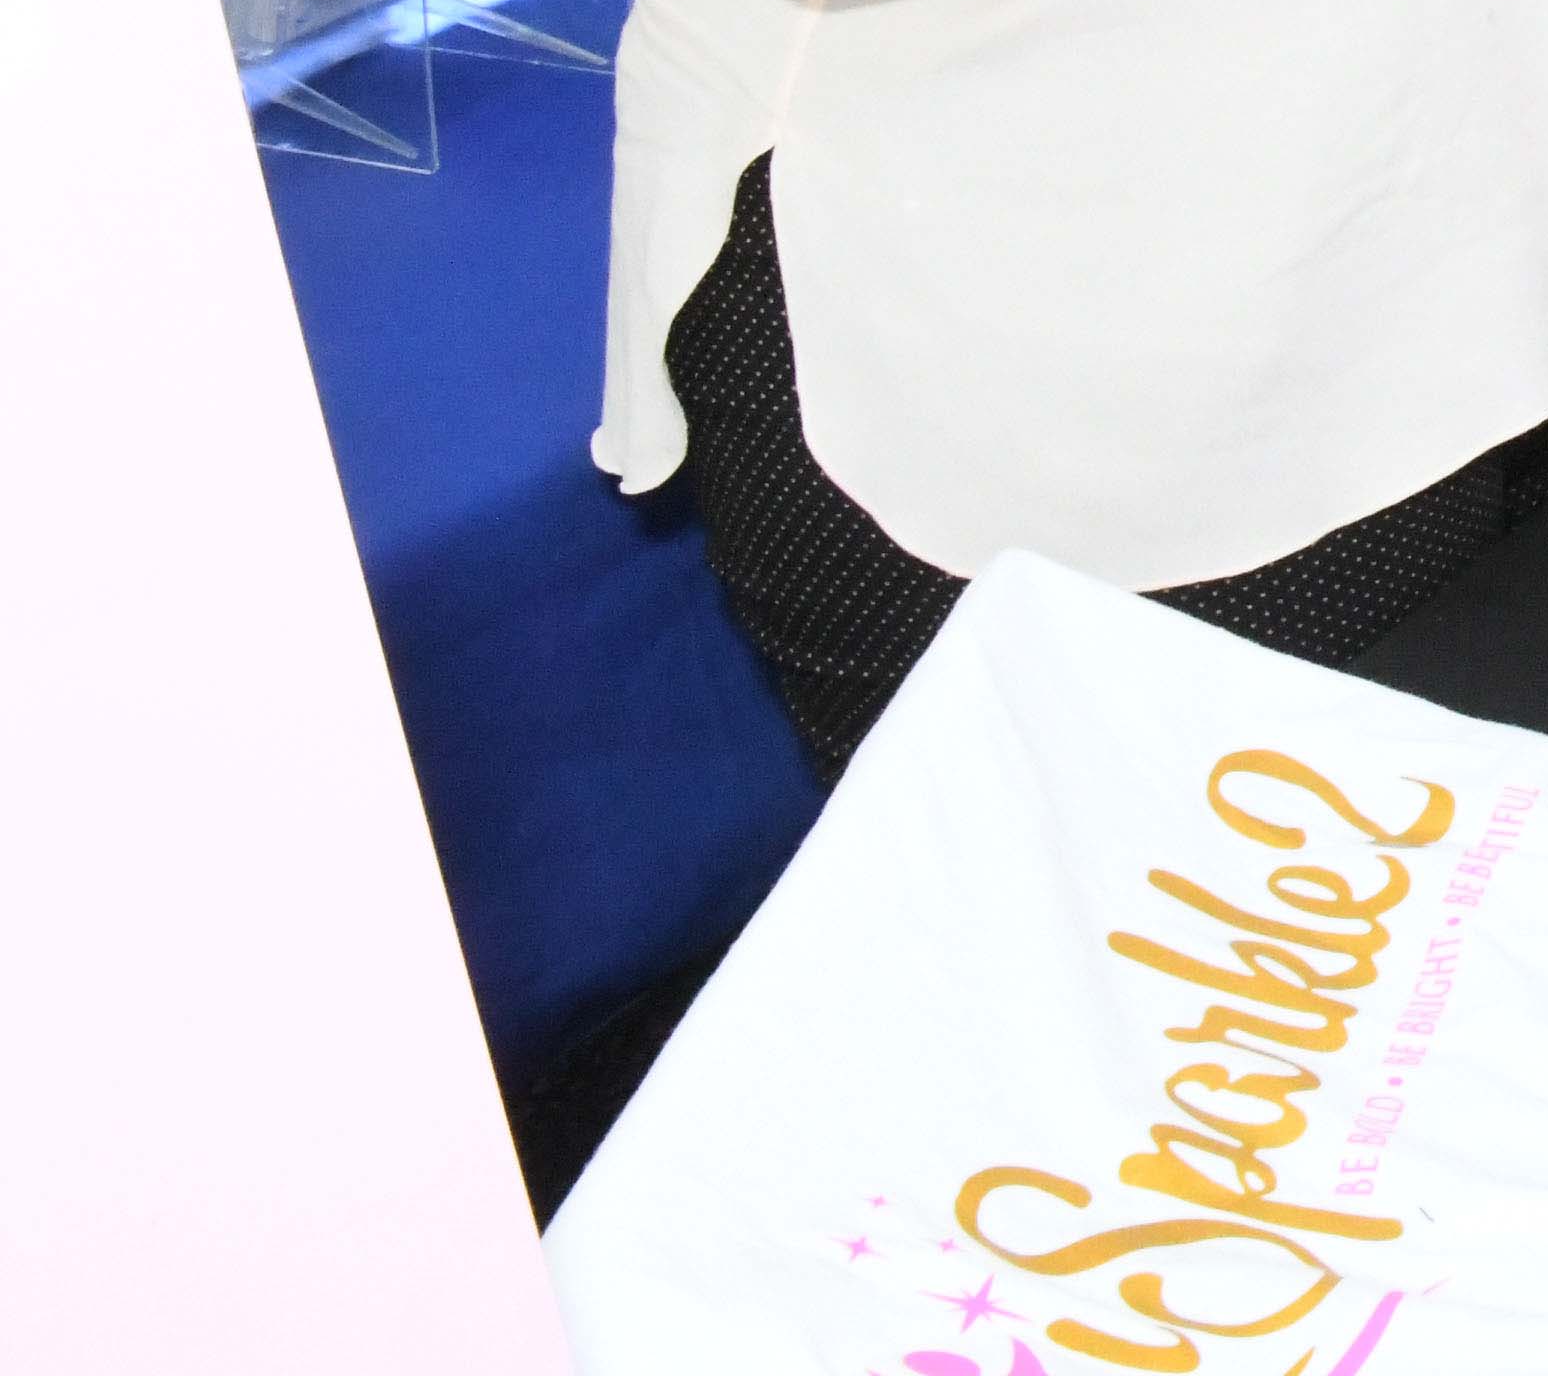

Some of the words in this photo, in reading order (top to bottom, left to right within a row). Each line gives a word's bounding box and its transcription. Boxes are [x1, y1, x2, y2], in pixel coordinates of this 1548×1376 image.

[1398, 936, 1463, 1036] BRIGHT
[954, 748, 1456, 1373] iSparkle2
[1384, 1041, 1428, 1067] BE
[1347, 1094, 1405, 1147] BOLD
[1334, 1155, 1379, 1198] BE
